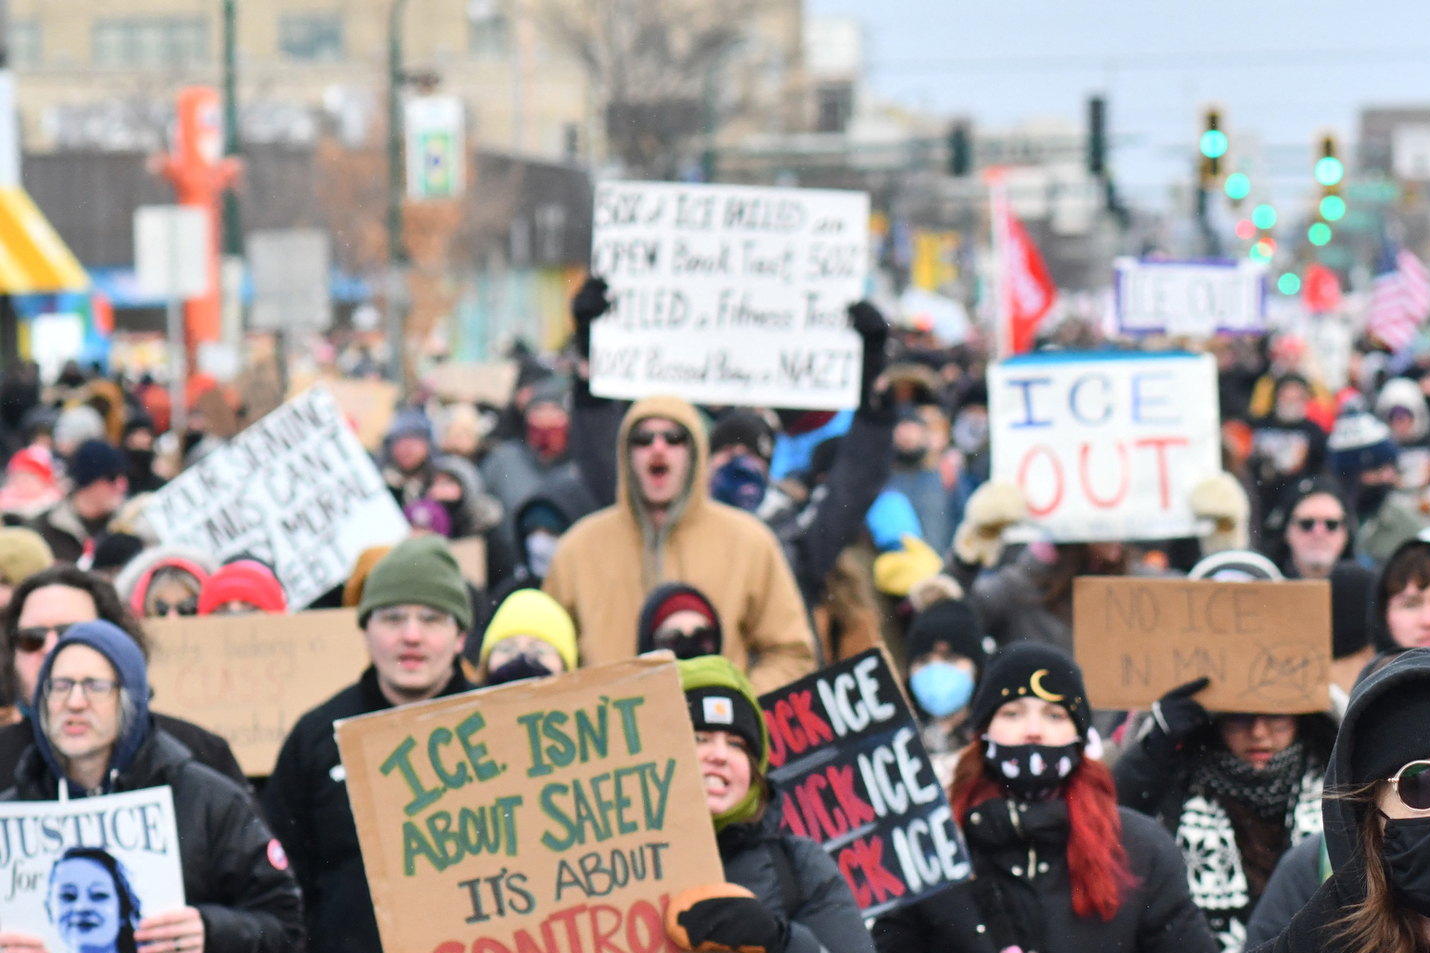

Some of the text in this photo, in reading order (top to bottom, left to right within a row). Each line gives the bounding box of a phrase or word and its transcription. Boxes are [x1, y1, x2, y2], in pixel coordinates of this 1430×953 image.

[674, 192, 717, 230] ICE
[592, 237, 663, 277] OPEN
[777, 347, 855, 390] NAZI
[1007, 370, 1183, 430] ICE
[1016, 436, 1189, 519] OUT
[280, 533, 352, 598] EBT
[1104, 586, 1266, 636] NO ICE
[816, 655, 897, 738] ICE
[1172, 646, 1229, 684] MN
[517, 695, 646, 778] ISN'T
[857, 726, 939, 818] ICE
[0, 803, 168, 869] JUSTICE
[402, 757, 677, 877] ABOUT SAFETY
[891, 804, 972, 895] ICE
[4, 858, 43, 900] for
[458, 841, 671, 925] IT'S ABOUT
